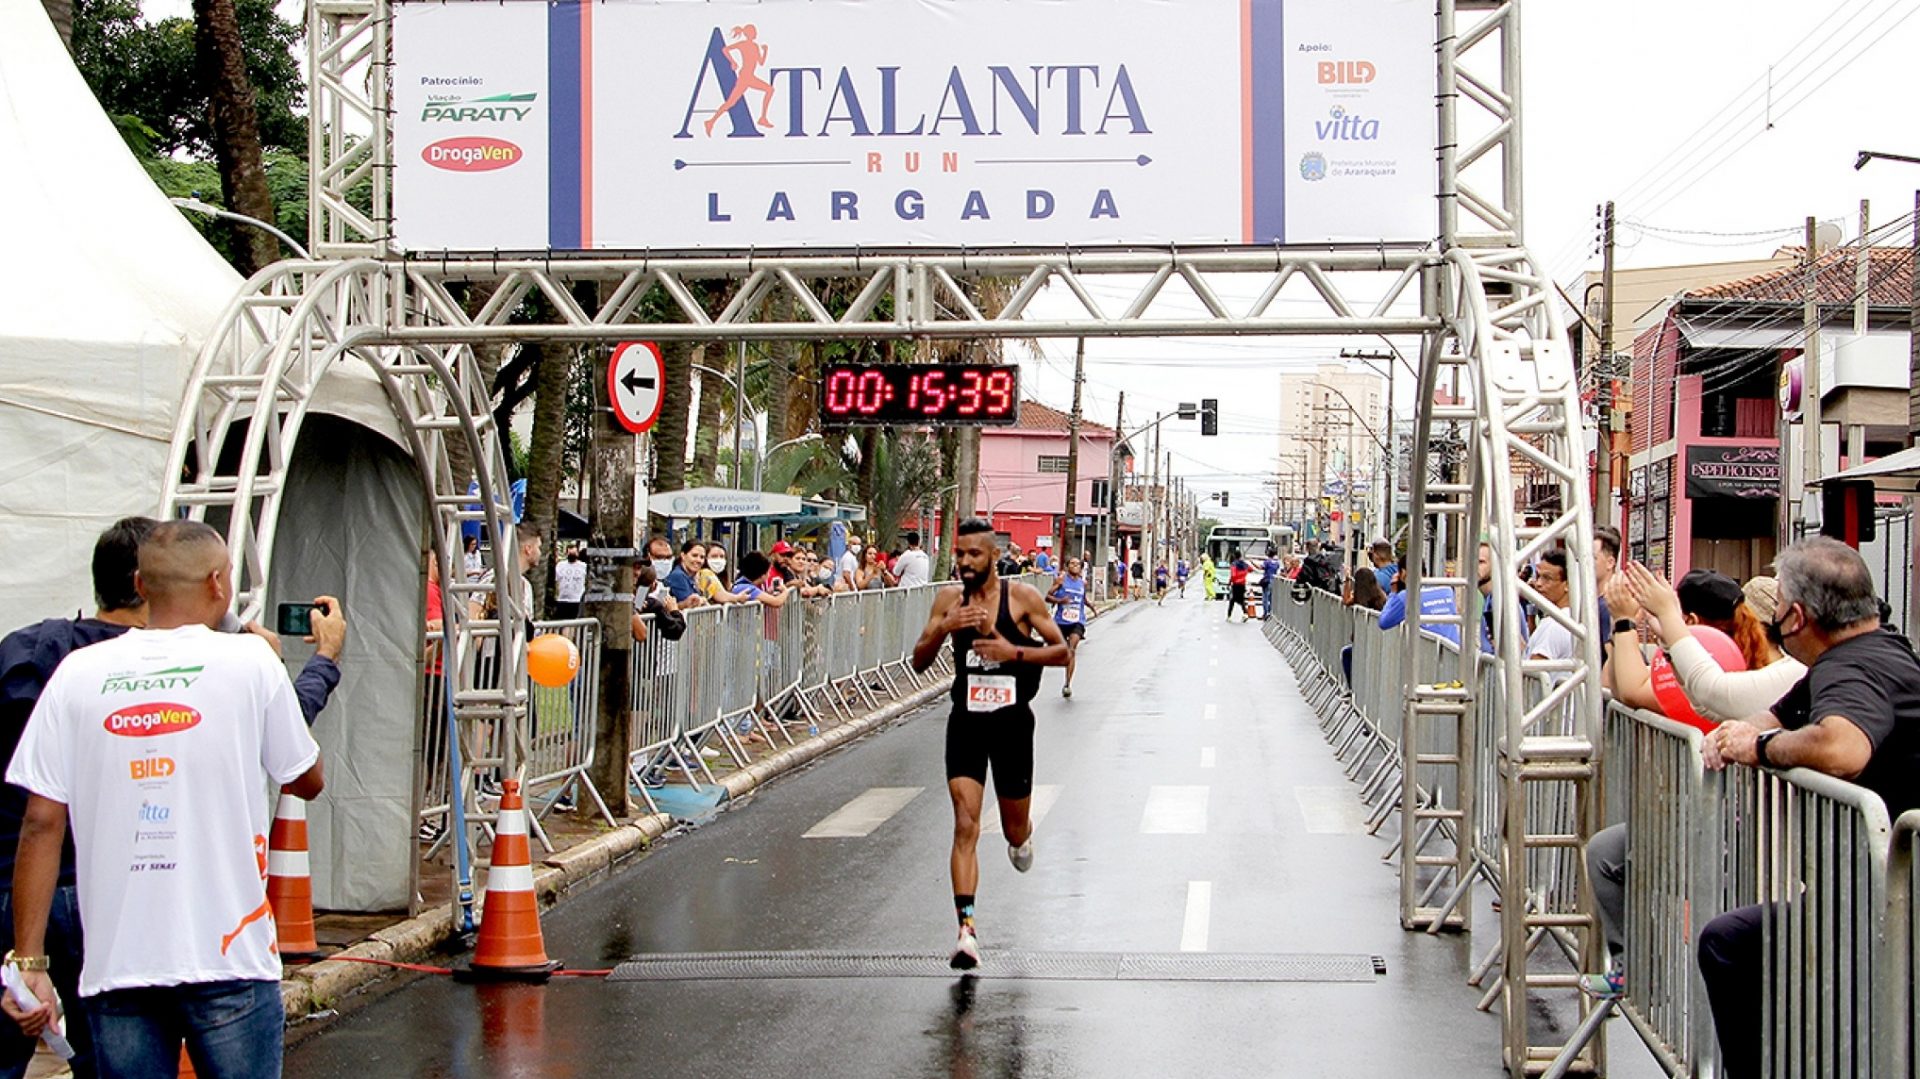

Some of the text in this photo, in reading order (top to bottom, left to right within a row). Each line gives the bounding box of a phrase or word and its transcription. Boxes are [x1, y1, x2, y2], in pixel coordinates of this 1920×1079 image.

[673, 27, 1153, 138] ATALANTA
[1317, 61, 1377, 84] BILD
[421, 107, 532, 122] PARATY
[1315, 109, 1380, 140] vitta
[430, 146, 514, 165] DrogaVen
[867, 152, 957, 173] RUN
[708, 189, 1120, 222] LARGADA
[707, 504, 760, 513] Araraquara
[101, 676, 199, 694] PARATY
[974, 688, 1006, 704] 465
[130, 757, 175, 779] BILD
